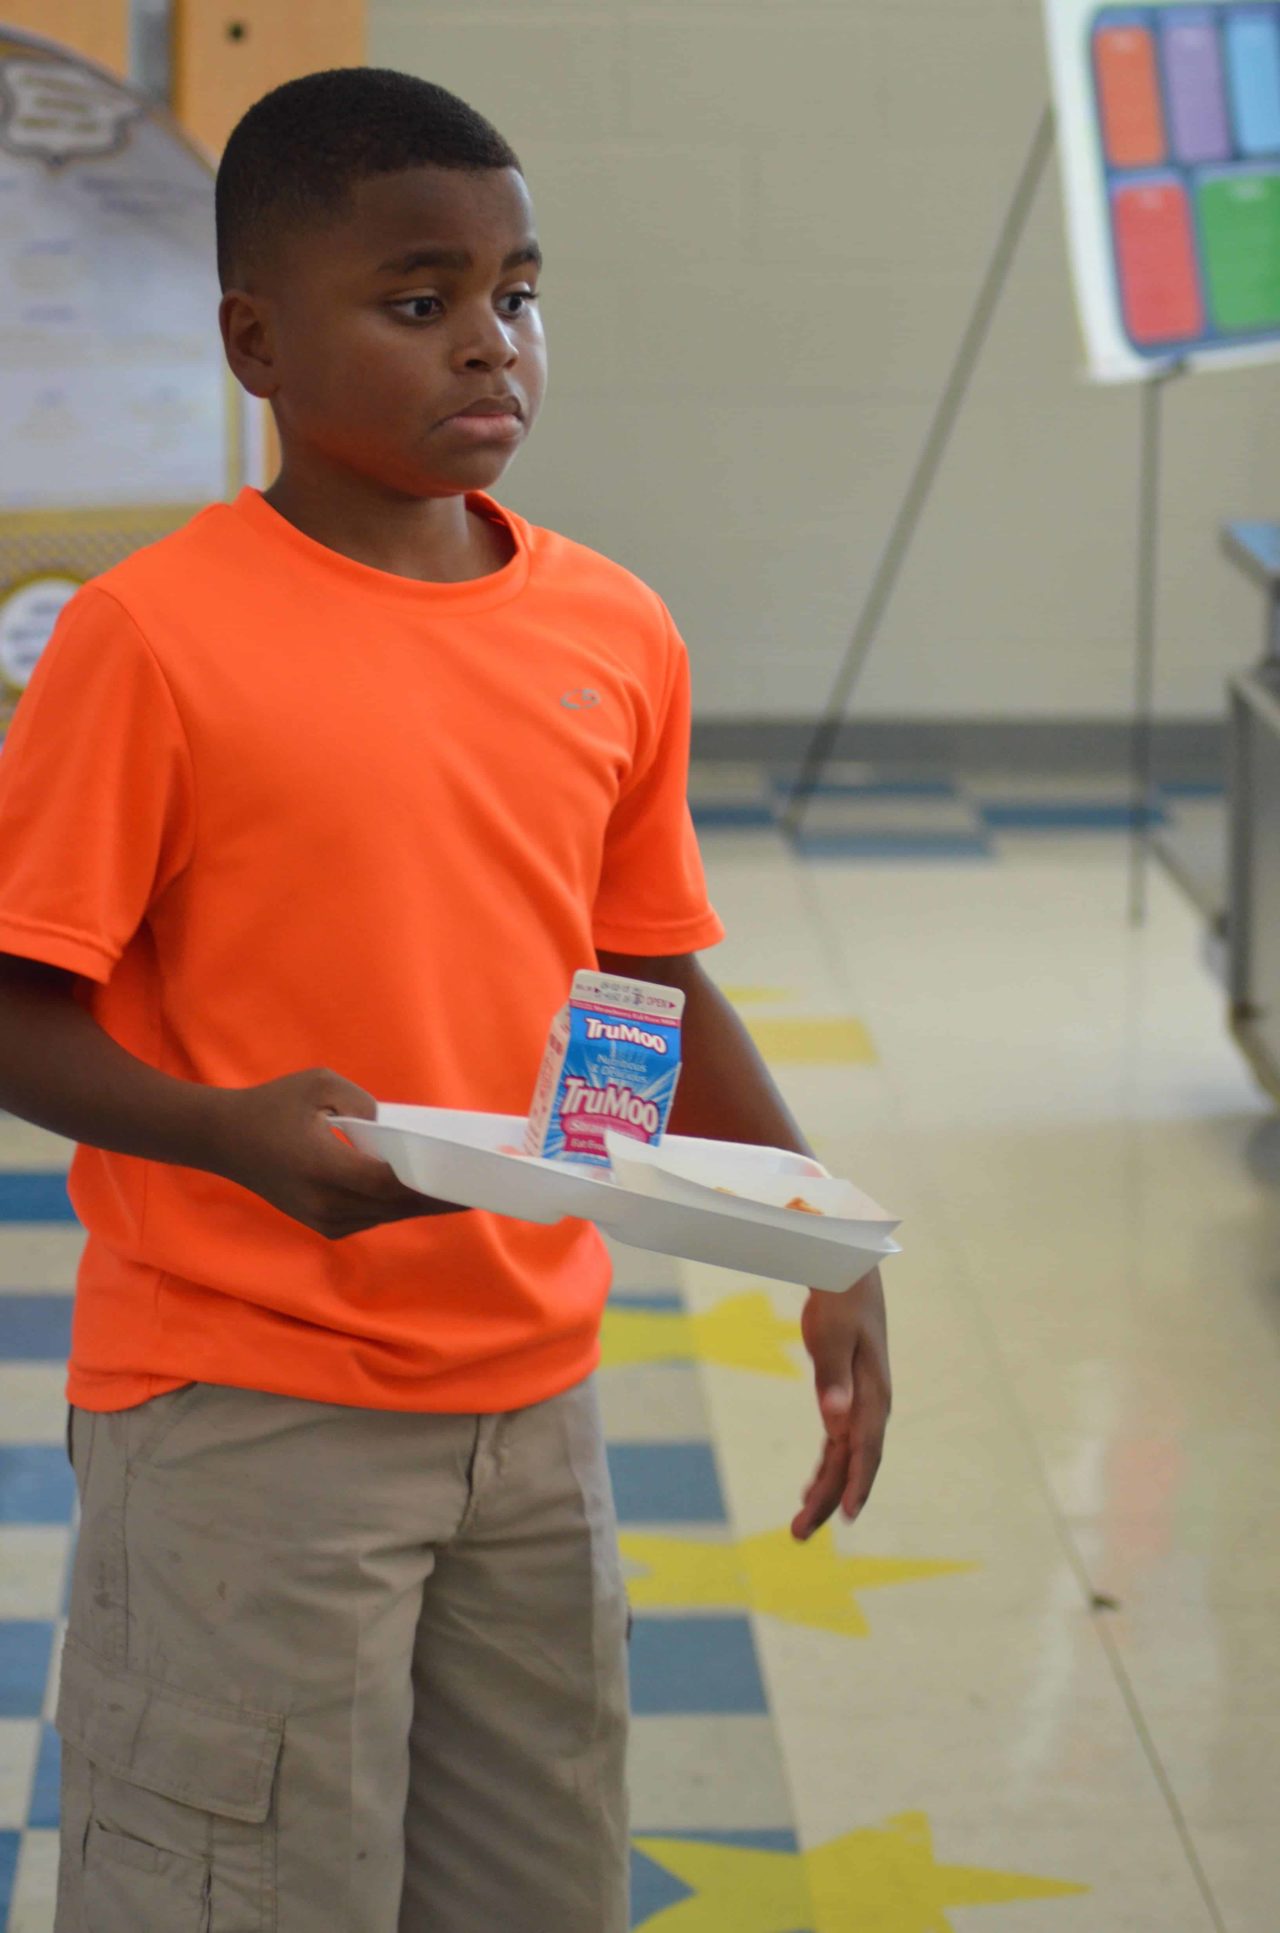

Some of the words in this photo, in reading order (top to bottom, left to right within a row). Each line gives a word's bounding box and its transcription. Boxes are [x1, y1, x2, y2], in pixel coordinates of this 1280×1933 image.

[646, 995, 668, 1009] OPEN
[585, 1017, 668, 1055] TruMoo
[560, 1075, 659, 1135] TruMoo
